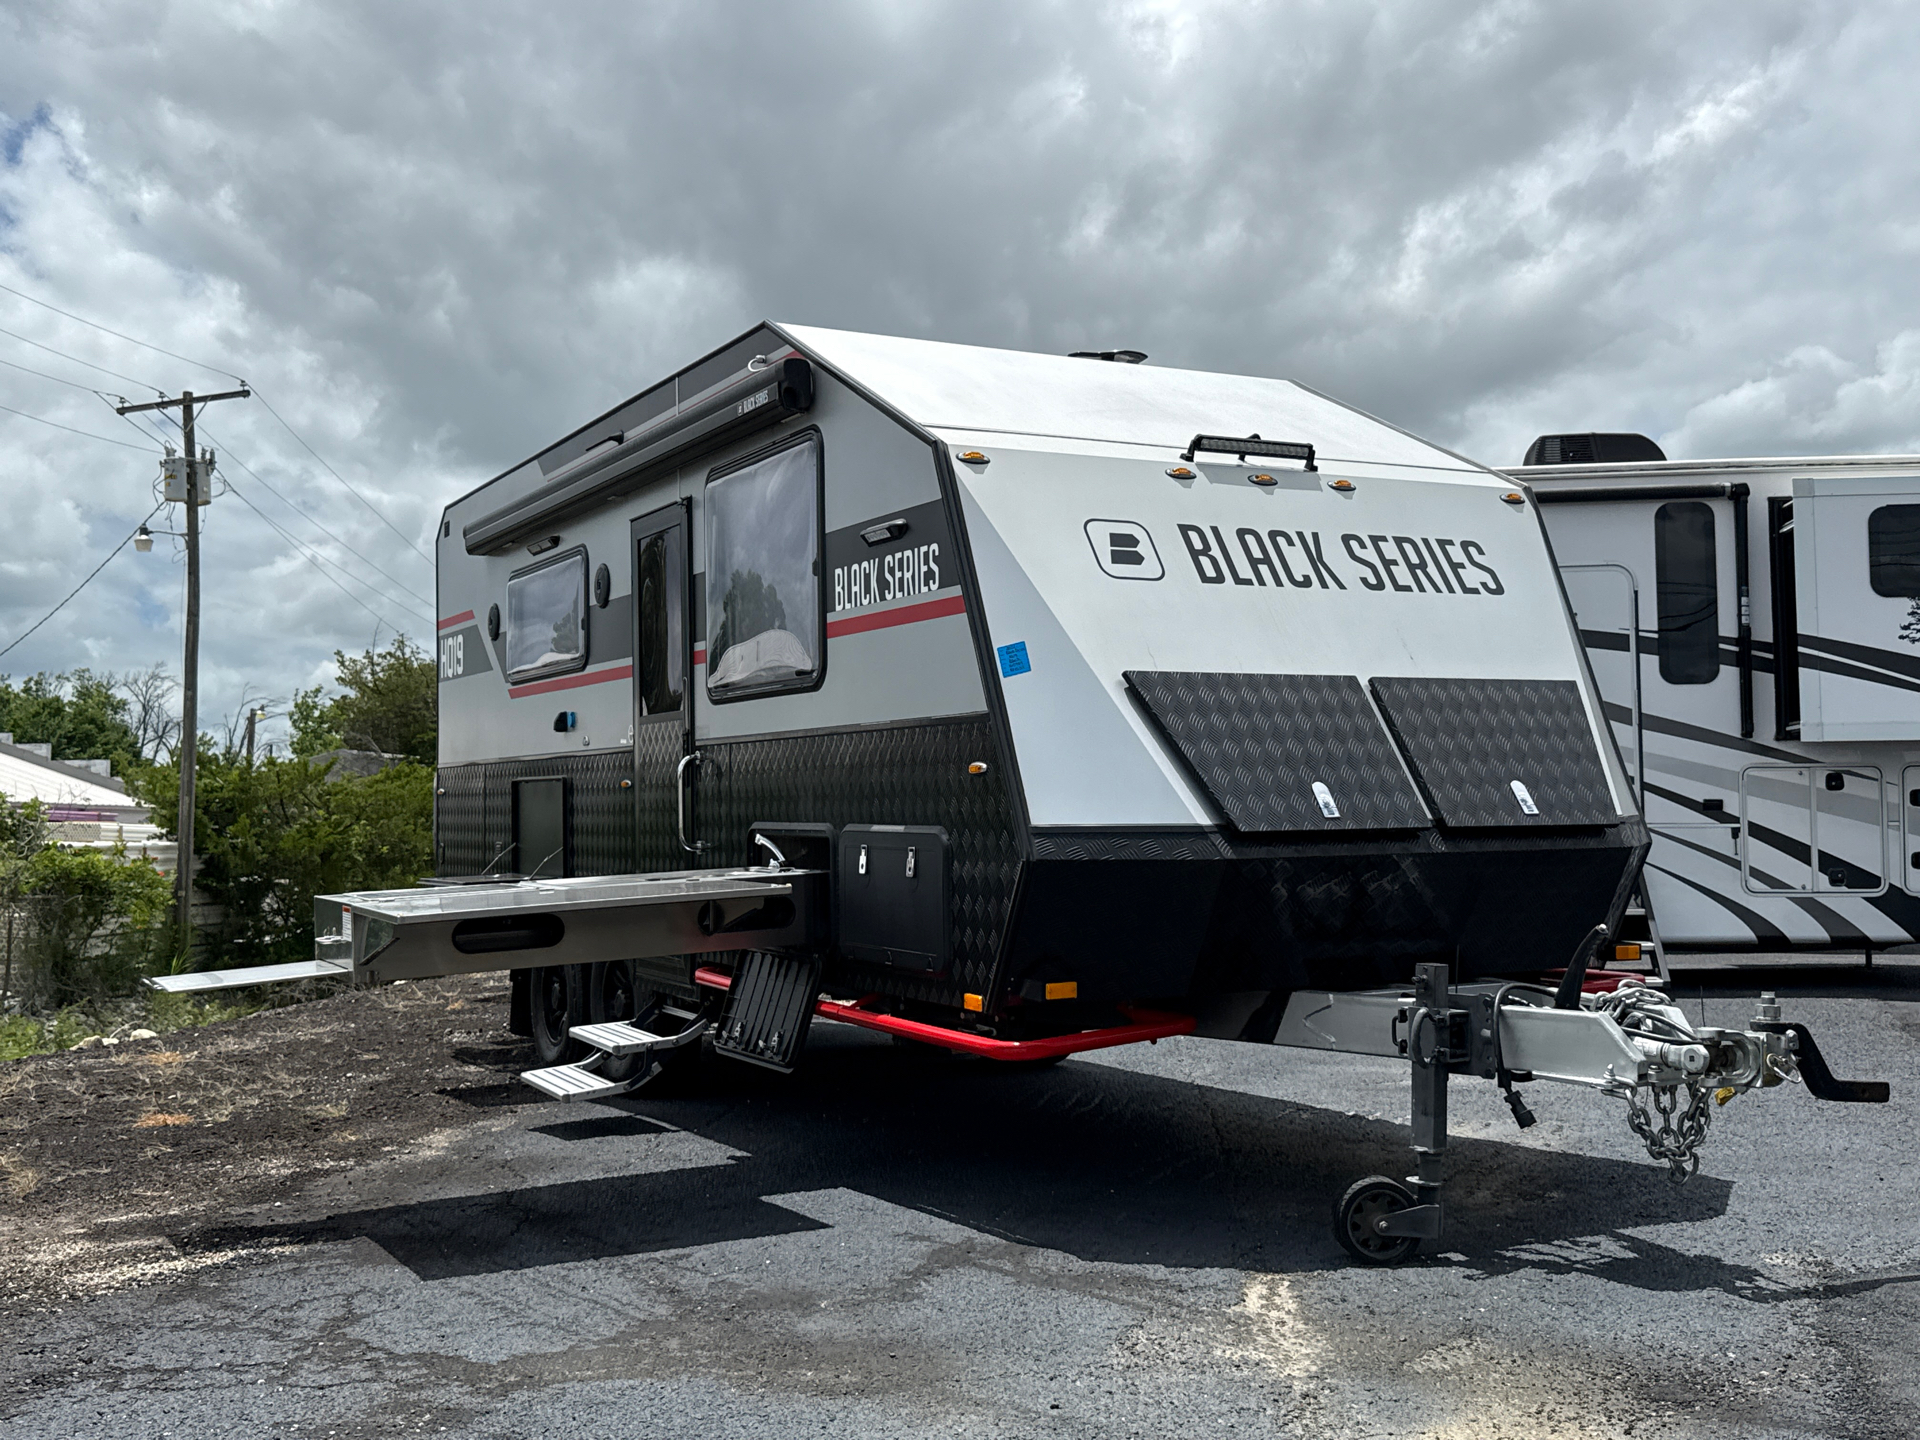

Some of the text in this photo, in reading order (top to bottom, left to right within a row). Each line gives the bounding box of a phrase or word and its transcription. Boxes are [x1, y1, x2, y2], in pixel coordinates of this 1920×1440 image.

[834, 542, 940, 612] BLACK SERIES
[1176, 523, 1348, 590] BLACK
[1340, 533, 1505, 596] SERIES
[440, 634, 464, 679] HQ19
